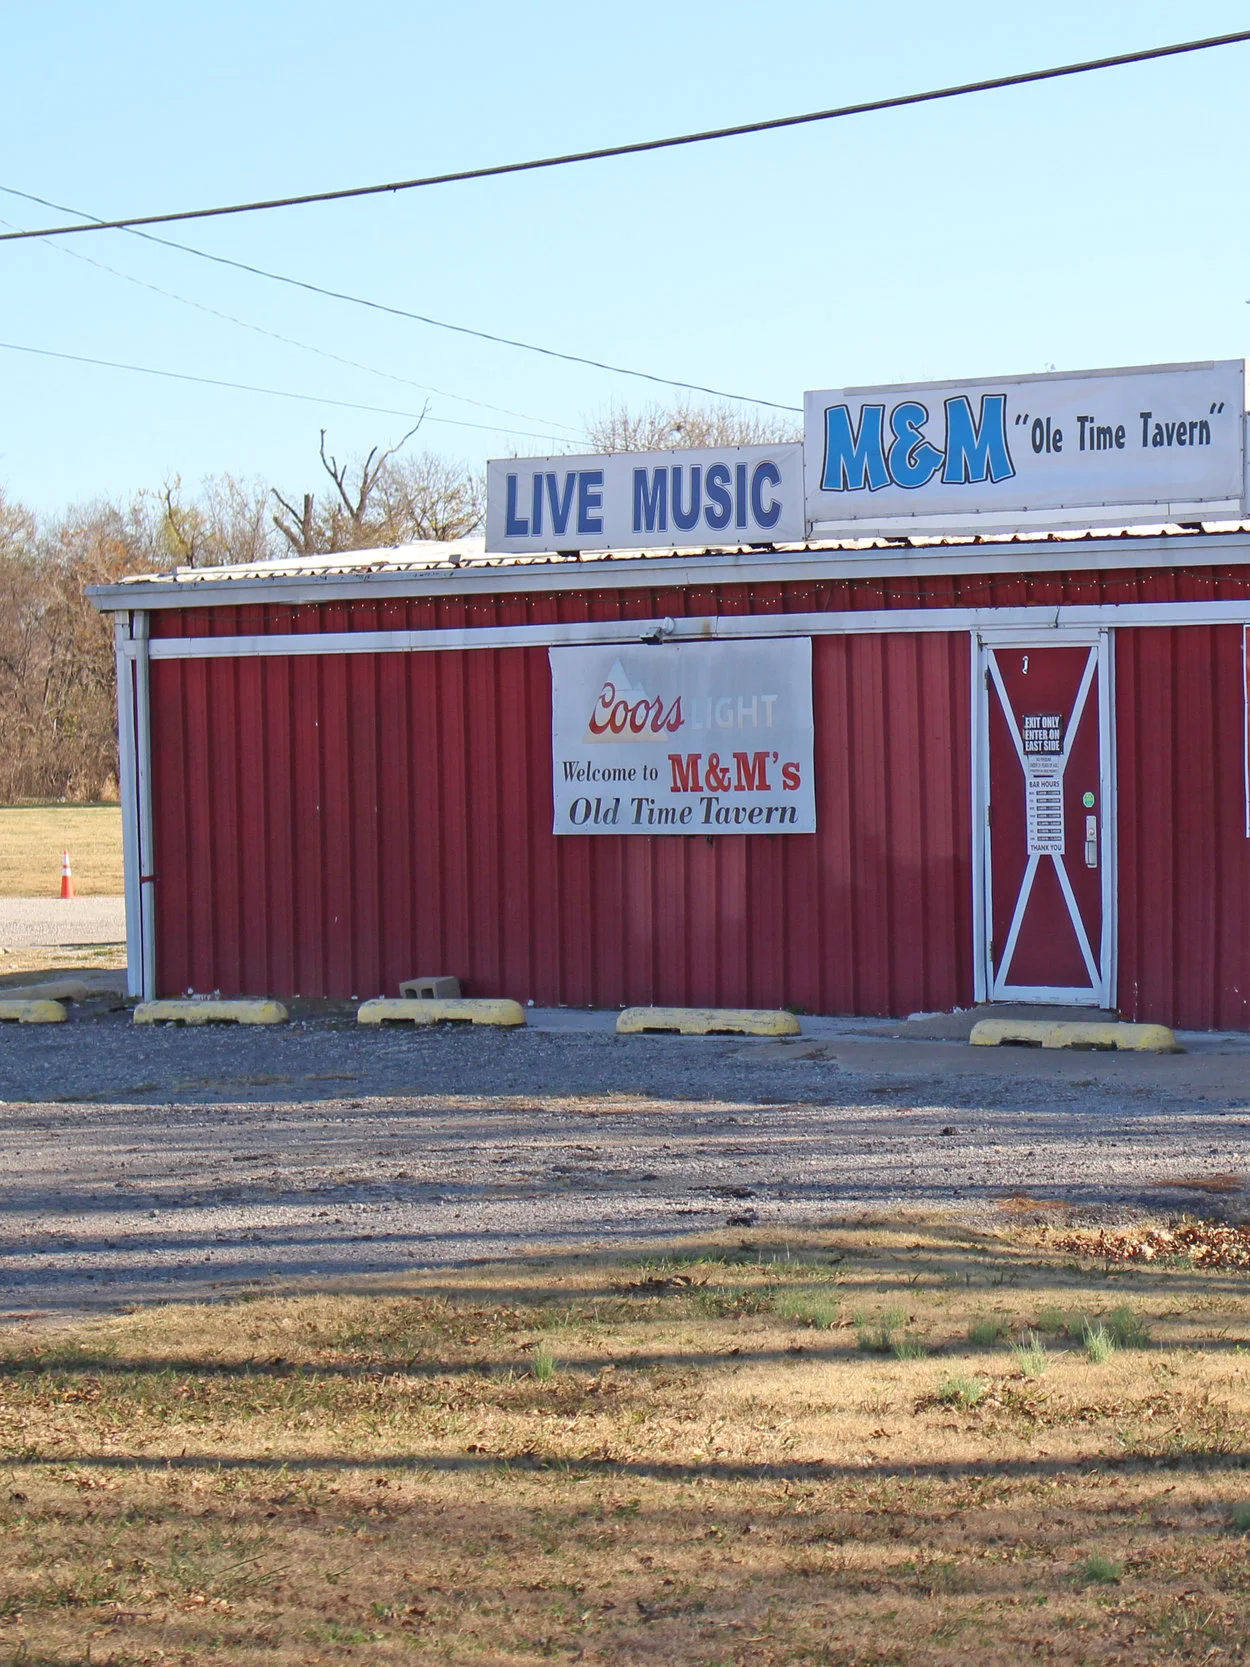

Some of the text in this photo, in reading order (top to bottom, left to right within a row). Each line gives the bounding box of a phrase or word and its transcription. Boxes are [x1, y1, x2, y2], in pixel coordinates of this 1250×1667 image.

[821, 393, 1016, 493] M&M
[1079, 415, 1126, 451] Time
[504, 461, 783, 538] LIVE MUSIC
[589, 682, 779, 734] Coors LIGHT
[1025, 716, 1060, 728] EXIT ONLY
[1025, 729, 1060, 740] ENTER ON
[1025, 740, 1060, 751] EAST SIDE
[562, 751, 801, 793] Welcome to M&M's
[569, 796, 799, 825] Old Time Tavern
